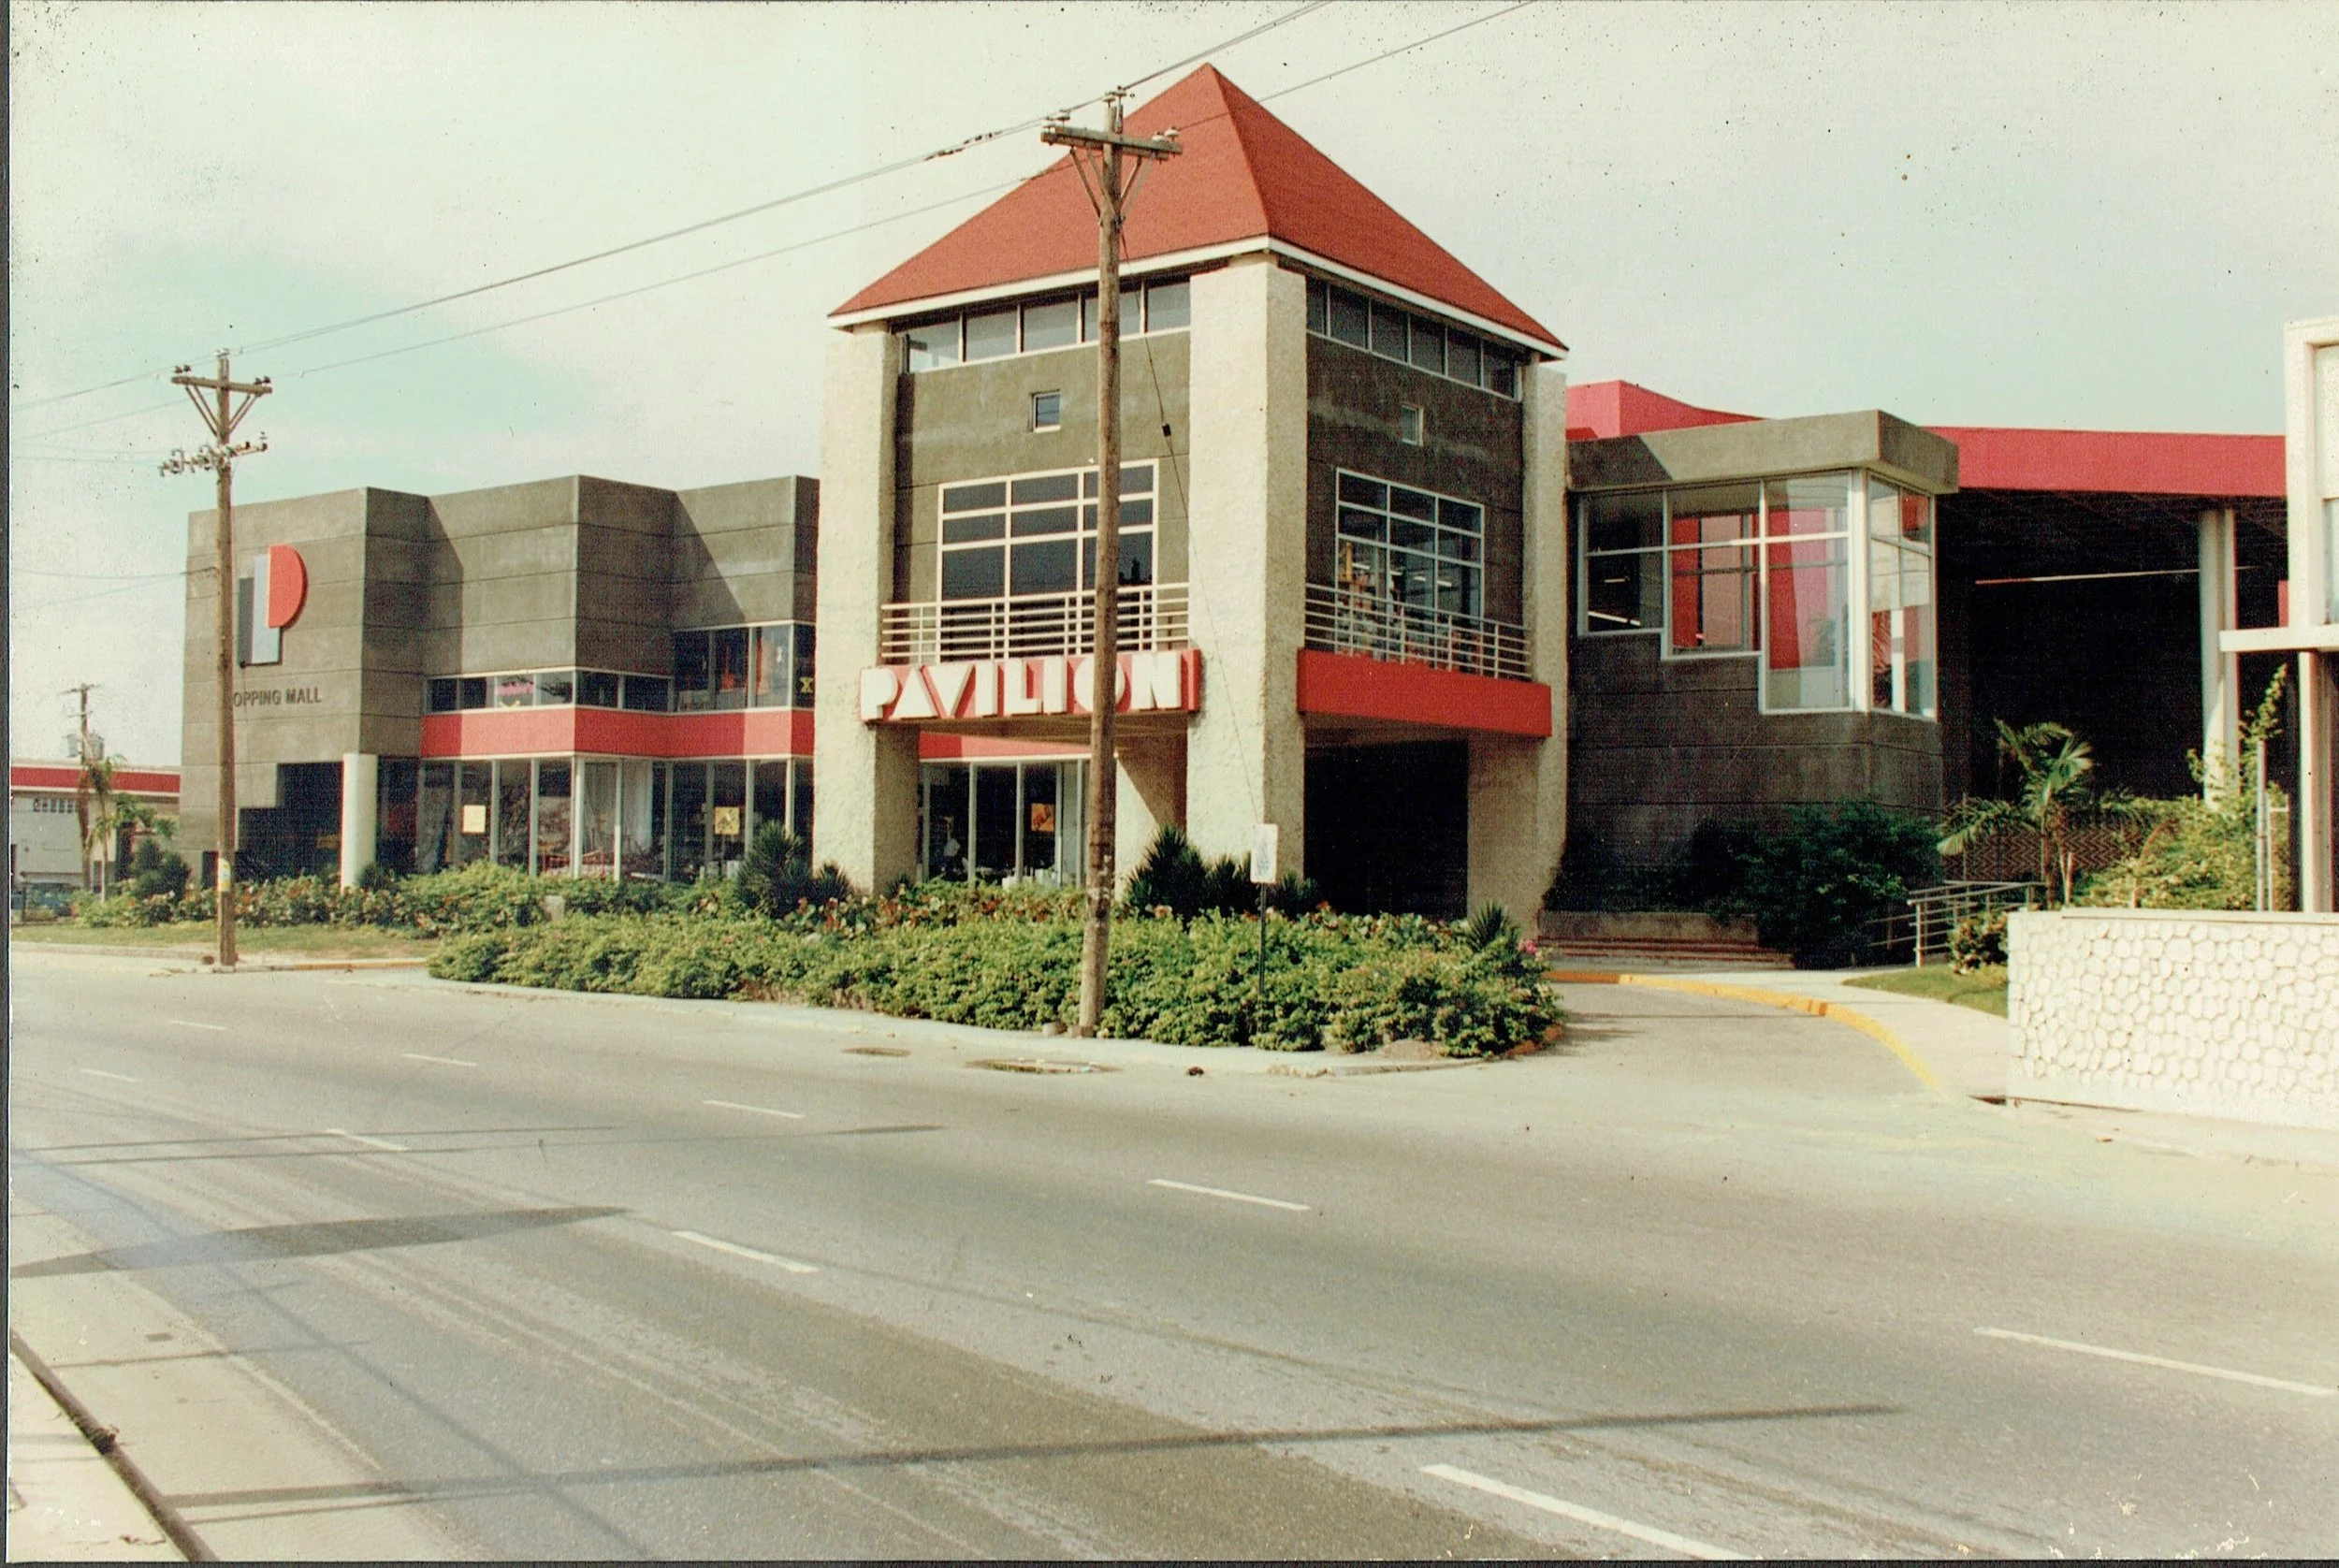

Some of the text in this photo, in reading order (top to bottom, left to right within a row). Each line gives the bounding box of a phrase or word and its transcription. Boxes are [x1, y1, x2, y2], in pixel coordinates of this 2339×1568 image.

[233, 687, 322, 707] OPPING MALL
[860, 652, 1183, 720] PAVILION
